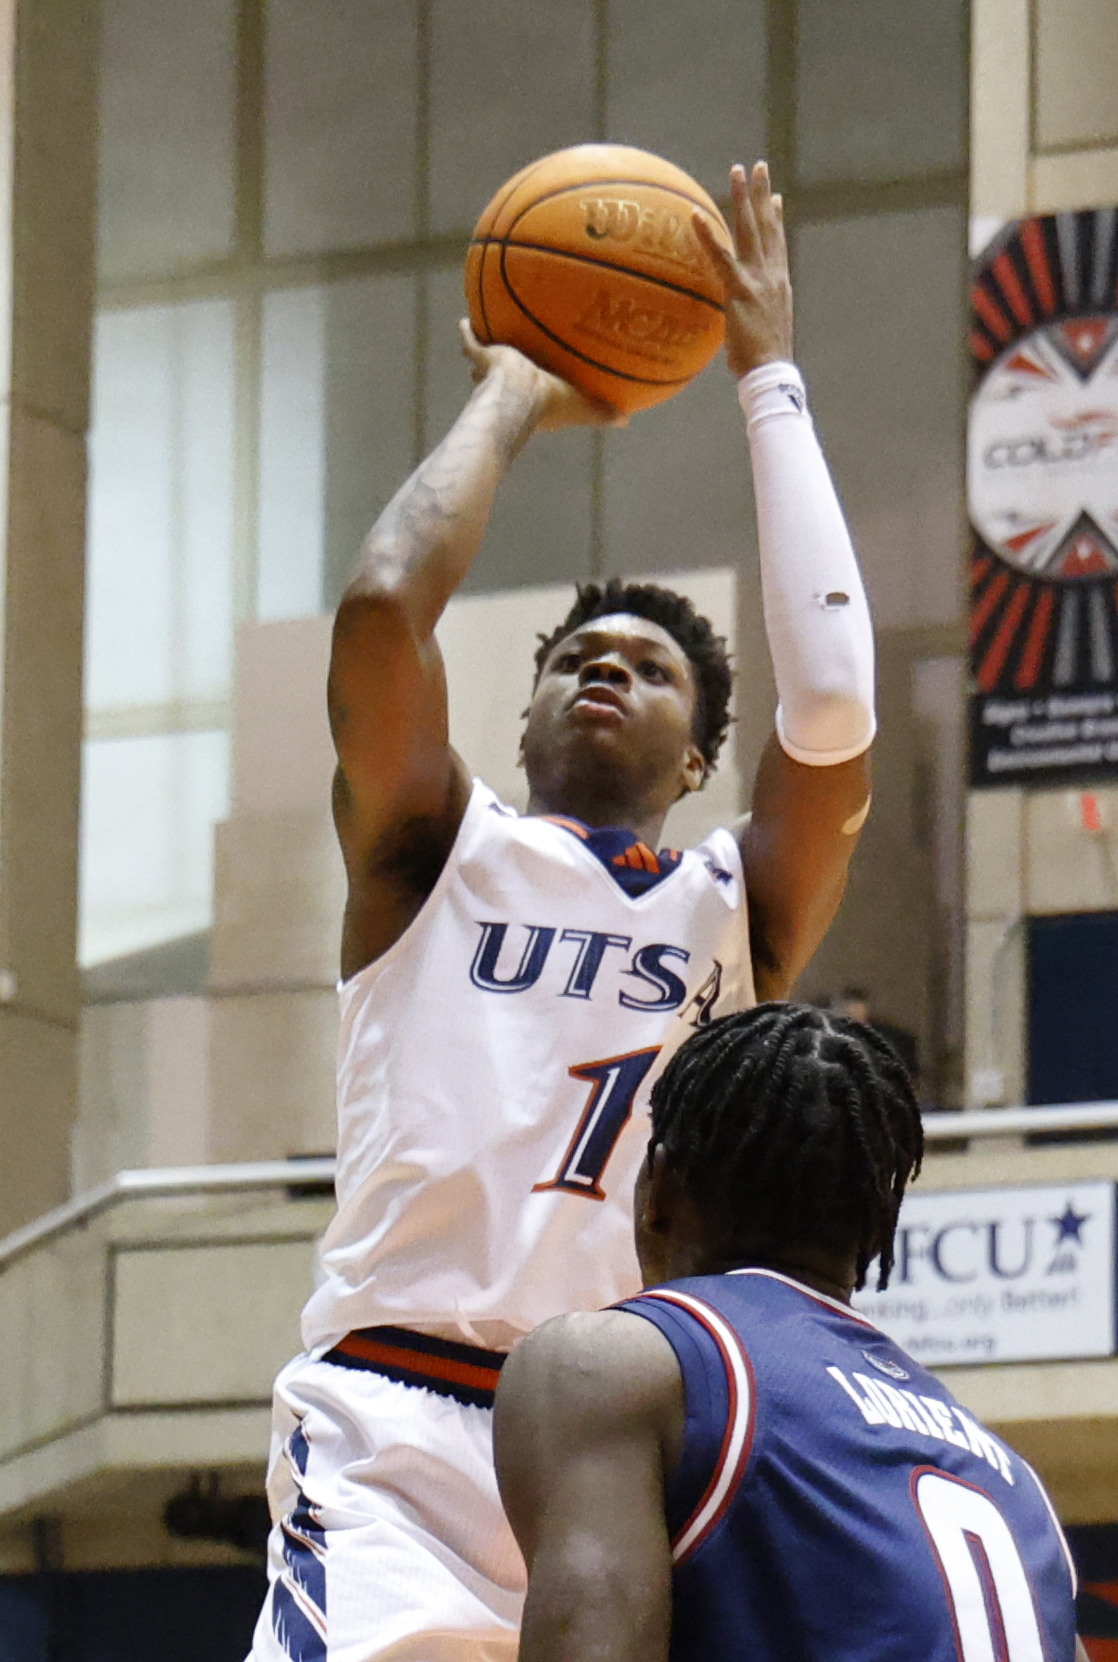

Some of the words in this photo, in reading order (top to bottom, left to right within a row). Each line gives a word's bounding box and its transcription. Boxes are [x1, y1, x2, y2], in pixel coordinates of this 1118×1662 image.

[469, 921, 722, 1028] UTSA
[531, 1045, 663, 1202] 1
[909, 1465, 1049, 1662] 0
